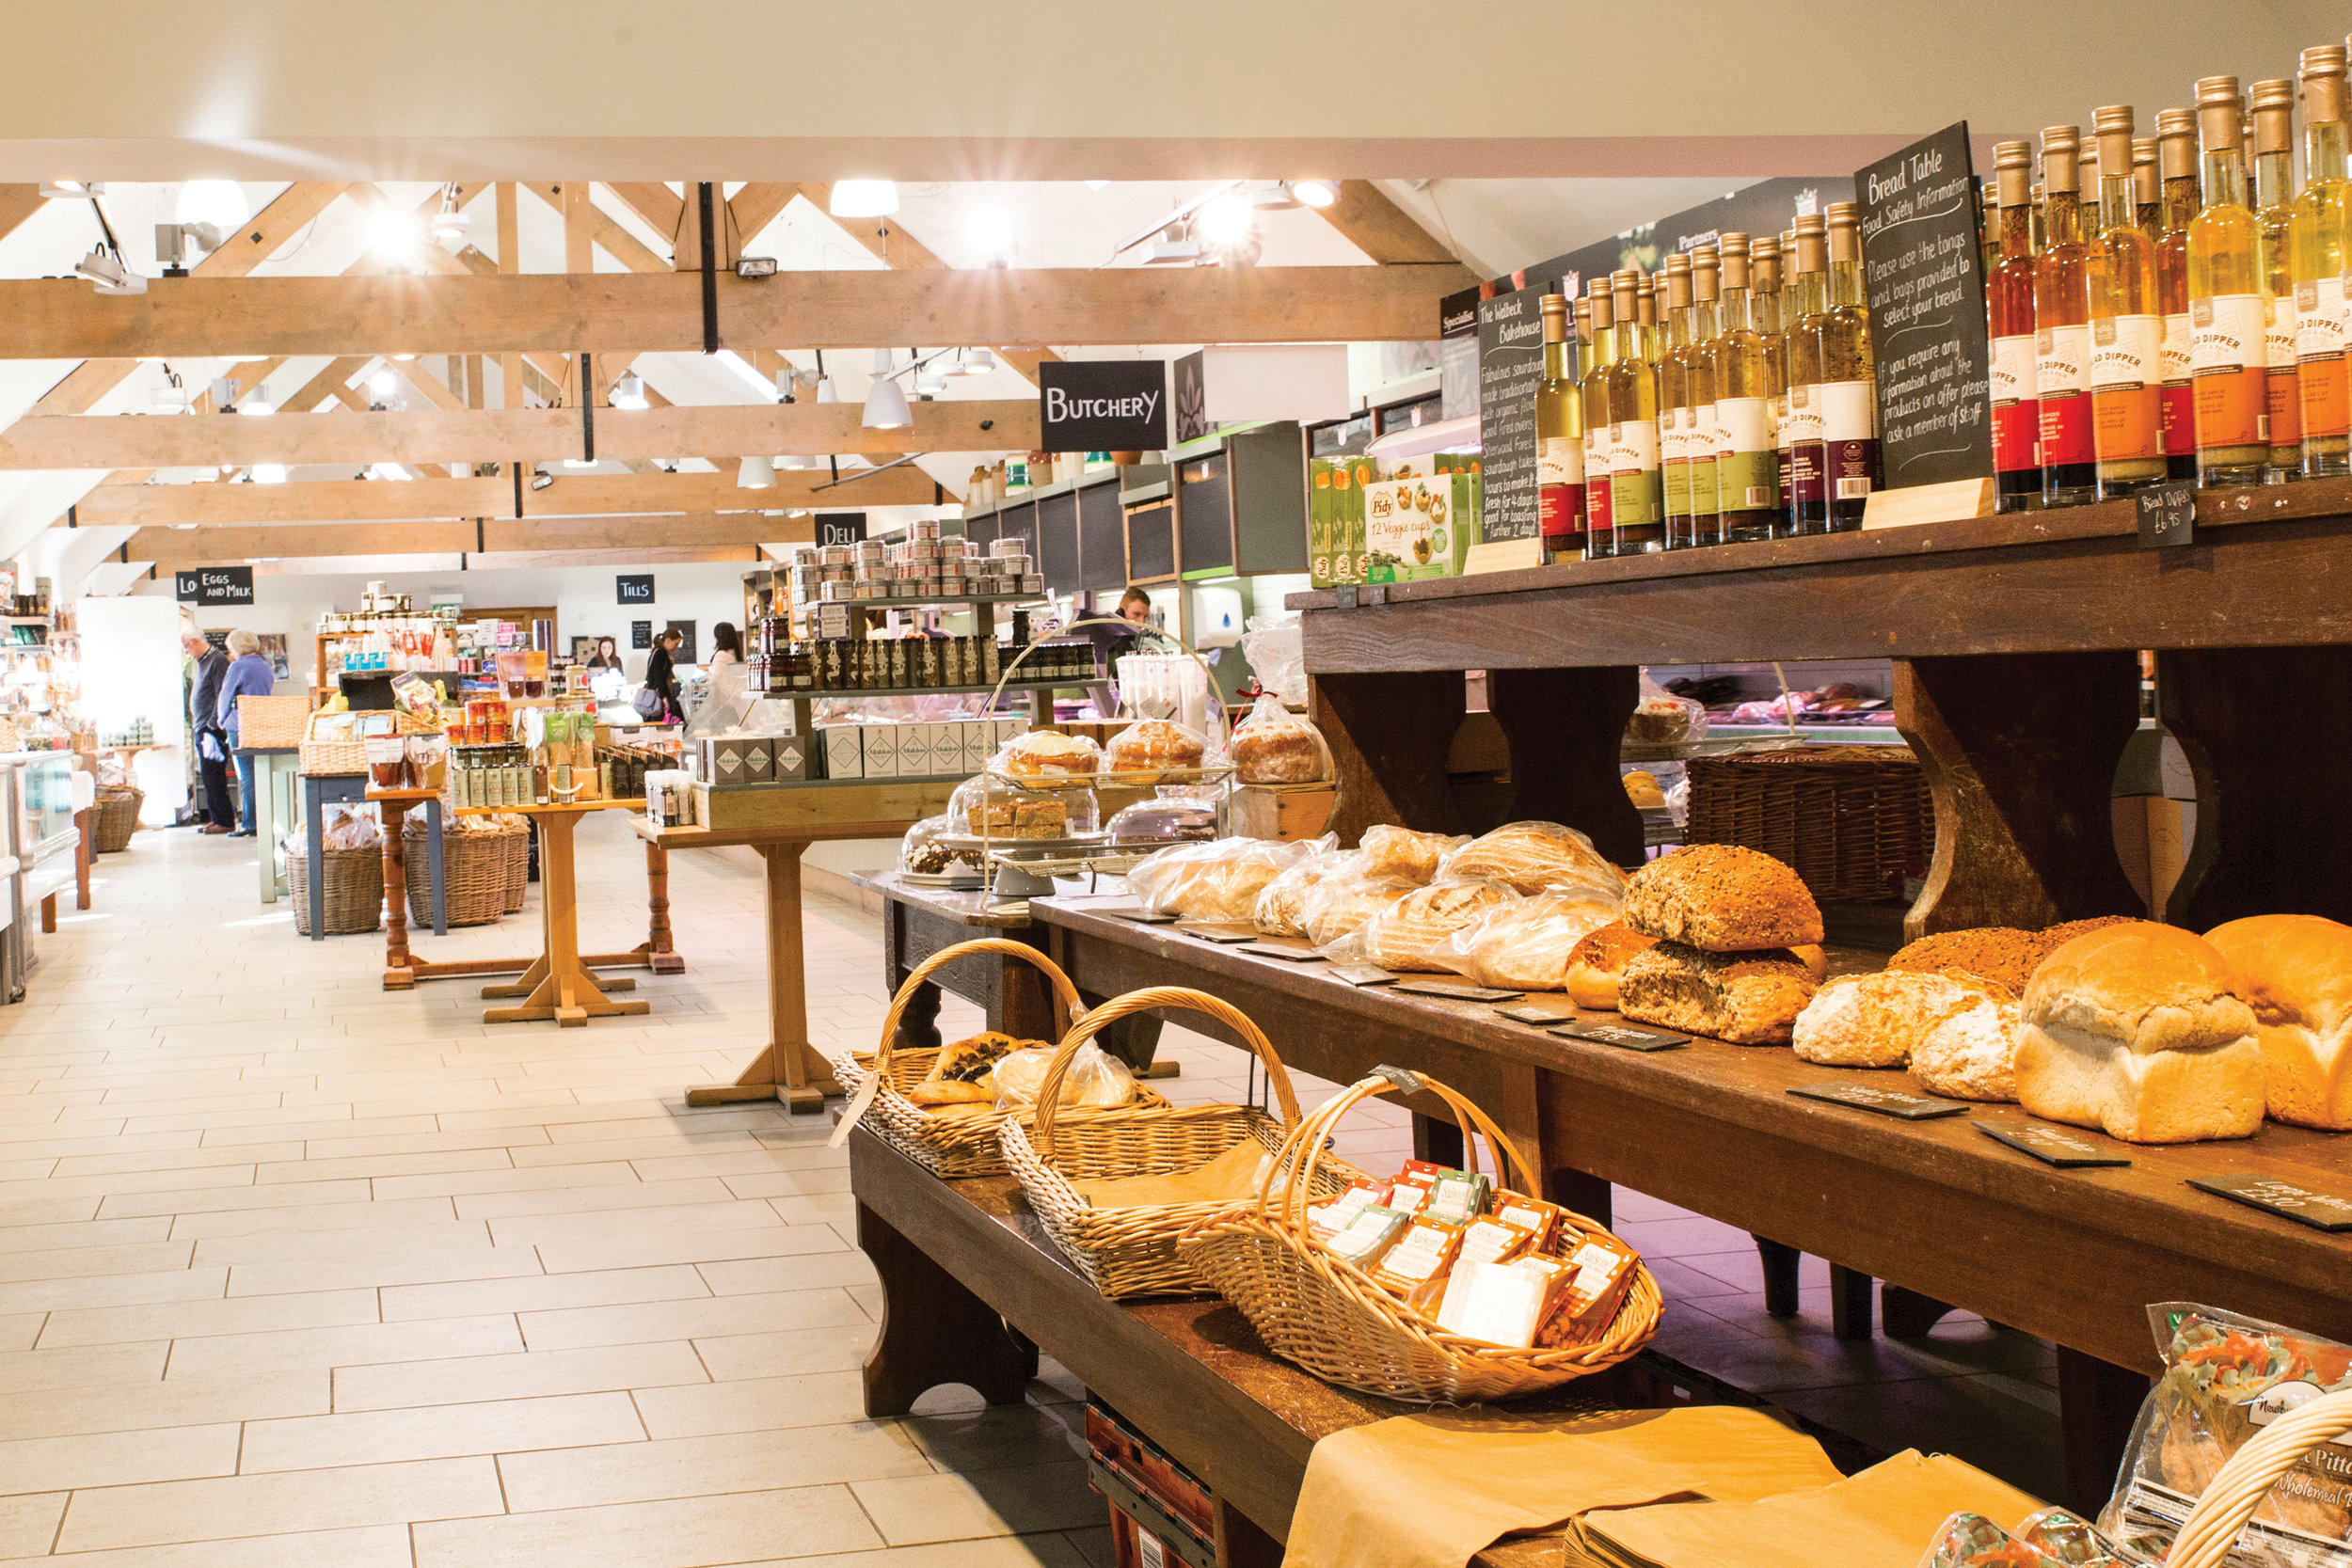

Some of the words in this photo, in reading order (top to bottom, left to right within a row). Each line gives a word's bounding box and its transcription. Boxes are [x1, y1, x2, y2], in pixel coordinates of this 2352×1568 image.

[1867, 160, 1907, 206] Bread
[1909, 148, 1943, 183] Table
[1862, 208, 1882, 236] Food
[1885, 199, 1914, 225] Safety
[1916, 177, 1969, 211] Information
[1678, 229, 1719, 251] Partners
[1867, 257, 1897, 284] Please
[1899, 248, 1916, 270] use
[1918, 240, 1935, 262] the
[1937, 231, 1965, 257] tongs
[1871, 283, 1891, 309] and
[1893, 272, 1915, 303] bags
[1916, 257, 1957, 297] provided
[1959, 257, 1970, 276] to
[1479, 306, 1494, 325] The
[1495, 297, 1523, 321] Welbeck
[1883, 301, 1911, 328] select
[1912, 297, 1933, 325] your
[1499, 321, 1541, 344] Bakehouse
[2202, 334, 2241, 350] DIPPER
[2265, 335, 2296, 348] DIPPE
[1481, 365, 1511, 385] Fabulous
[1513, 356, 1545, 378] sourdoug
[1877, 360, 1886, 385] If
[1889, 358, 1906, 383] you
[1907, 343, 1939, 370] require
[1941, 339, 1961, 360] any
[2044, 361, 2078, 376] DIPPER
[2105, 352, 2141, 368] DIPPER
[1881, 374, 1928, 406] information
[1930, 361, 1954, 384] about
[1958, 357, 1973, 375] the
[1046, 387, 1159, 424] BUTCHERY
[1883, 396, 1921, 427] products
[1922, 395, 1935, 410] on
[1937, 385, 1960, 408] offer
[1962, 379, 1989, 404] please
[1886, 425, 1905, 444] ask
[1905, 426, 1914, 438] a
[1914, 411, 1947, 436] member
[1948, 407, 1959, 435] of
[1959, 402, 1982, 427] staff
[1483, 437, 1514, 459] Sherwood
[1615, 447, 1640, 459] DIPPER
[1484, 458, 1518, 478] sourdough
[1518, 456, 1537, 469] takes
[1541, 462, 1565, 473] DIPPER
[1484, 479, 1502, 495] hours
[1503, 478, 1511, 492] to
[1373, 499, 1393, 515] Pidy
[1484, 496, 1502, 514] fresh
[1502, 494, 1511, 510] for
[1511, 494, 1518, 508] 4
[1517, 491, 1534, 513] days
[2141, 493, 2164, 513] Bread
[1372, 523, 1382, 536] 12
[1383, 520, 1409, 540] Veggie
[1410, 520, 1431, 540] cups
[1484, 509, 1500, 530] good
[1501, 509, 1509, 527] for
[1510, 509, 1537, 526] toasting
[1489, 524, 1512, 540] further
[1512, 523, 1519, 538] 2
[1319, 558, 1327, 577] Pidy
[202, 573, 230, 586] EGGS
[620, 582, 649, 597] TILLS
[207, 588, 226, 596] AND
[226, 584, 252, 598] MILK
